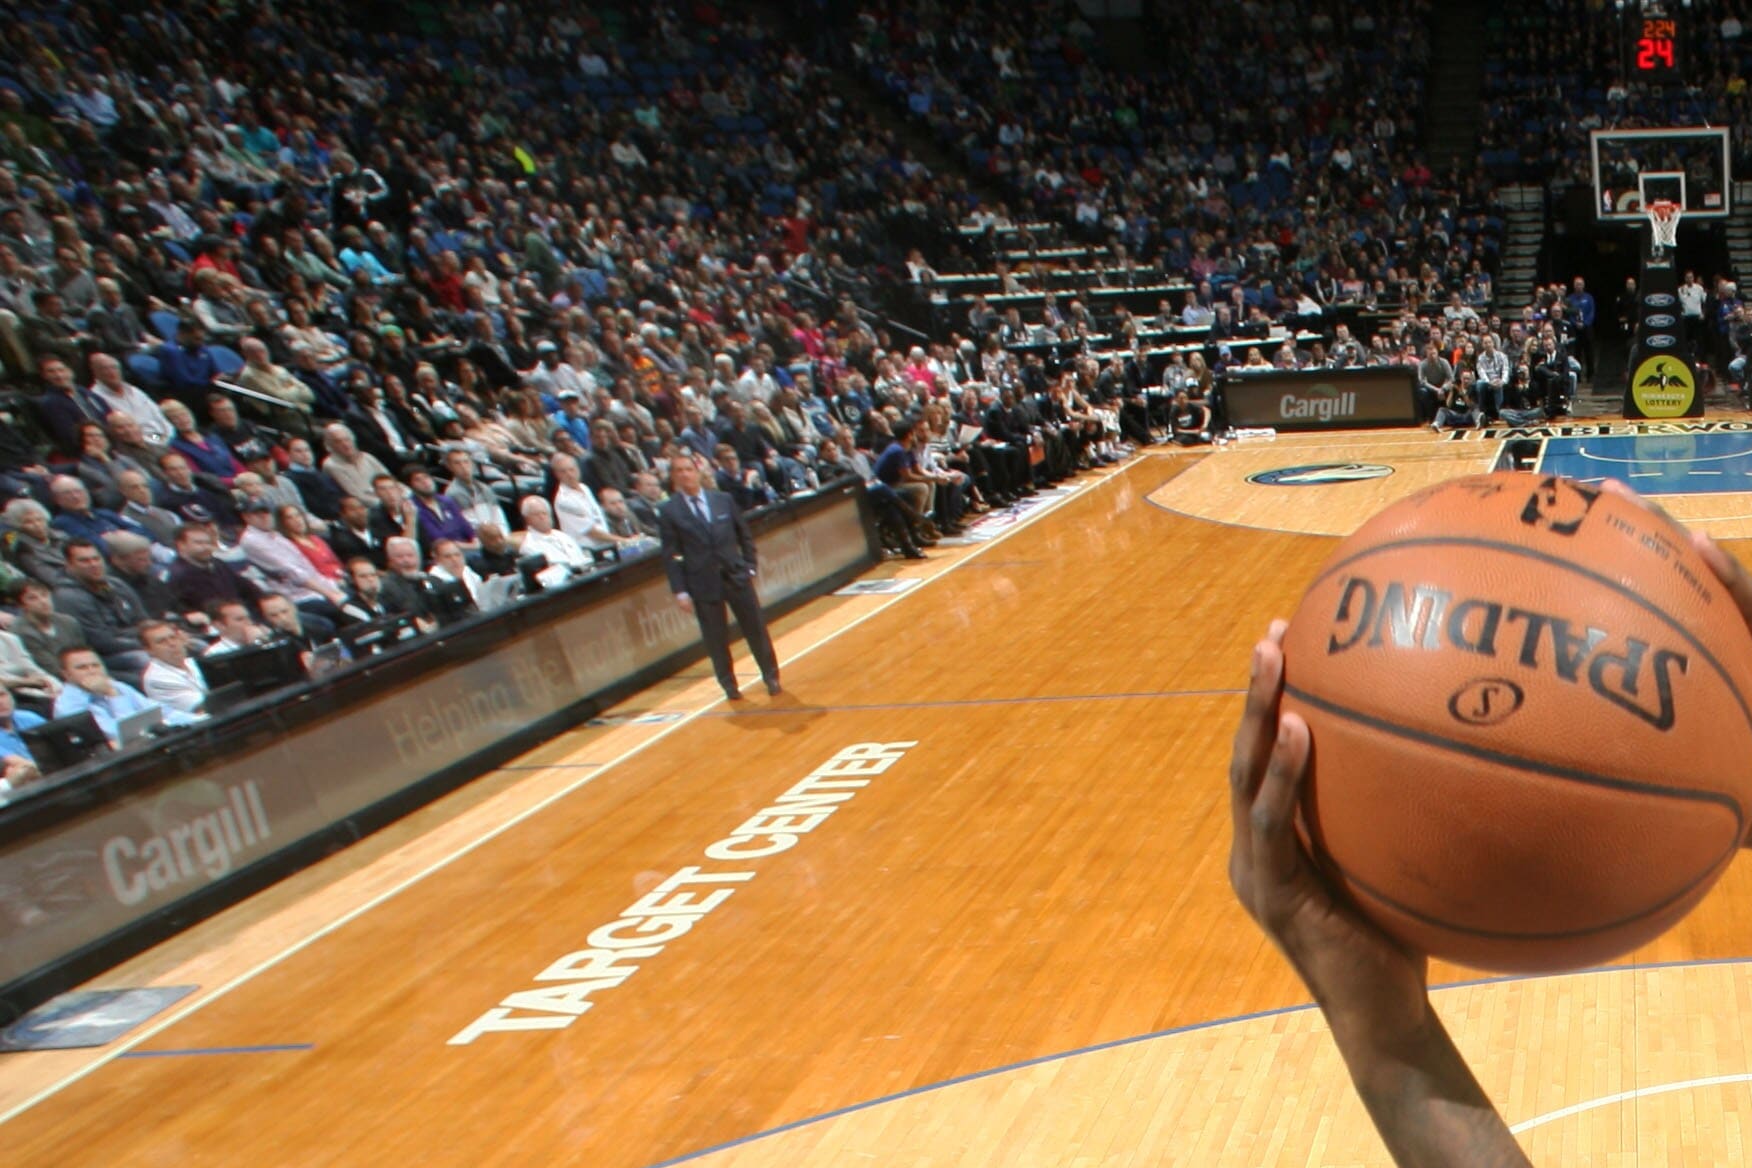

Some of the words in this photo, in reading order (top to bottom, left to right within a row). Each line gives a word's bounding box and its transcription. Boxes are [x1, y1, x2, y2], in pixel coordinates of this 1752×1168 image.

[1636, 39, 1674, 69] 24
[1280, 392, 1356, 422] Cargill
[1327, 576, 1689, 732] SPALDING
[102, 780, 271, 906] Cargill
[446, 866, 756, 1045] TARGET
[704, 740, 919, 860] CENTER
